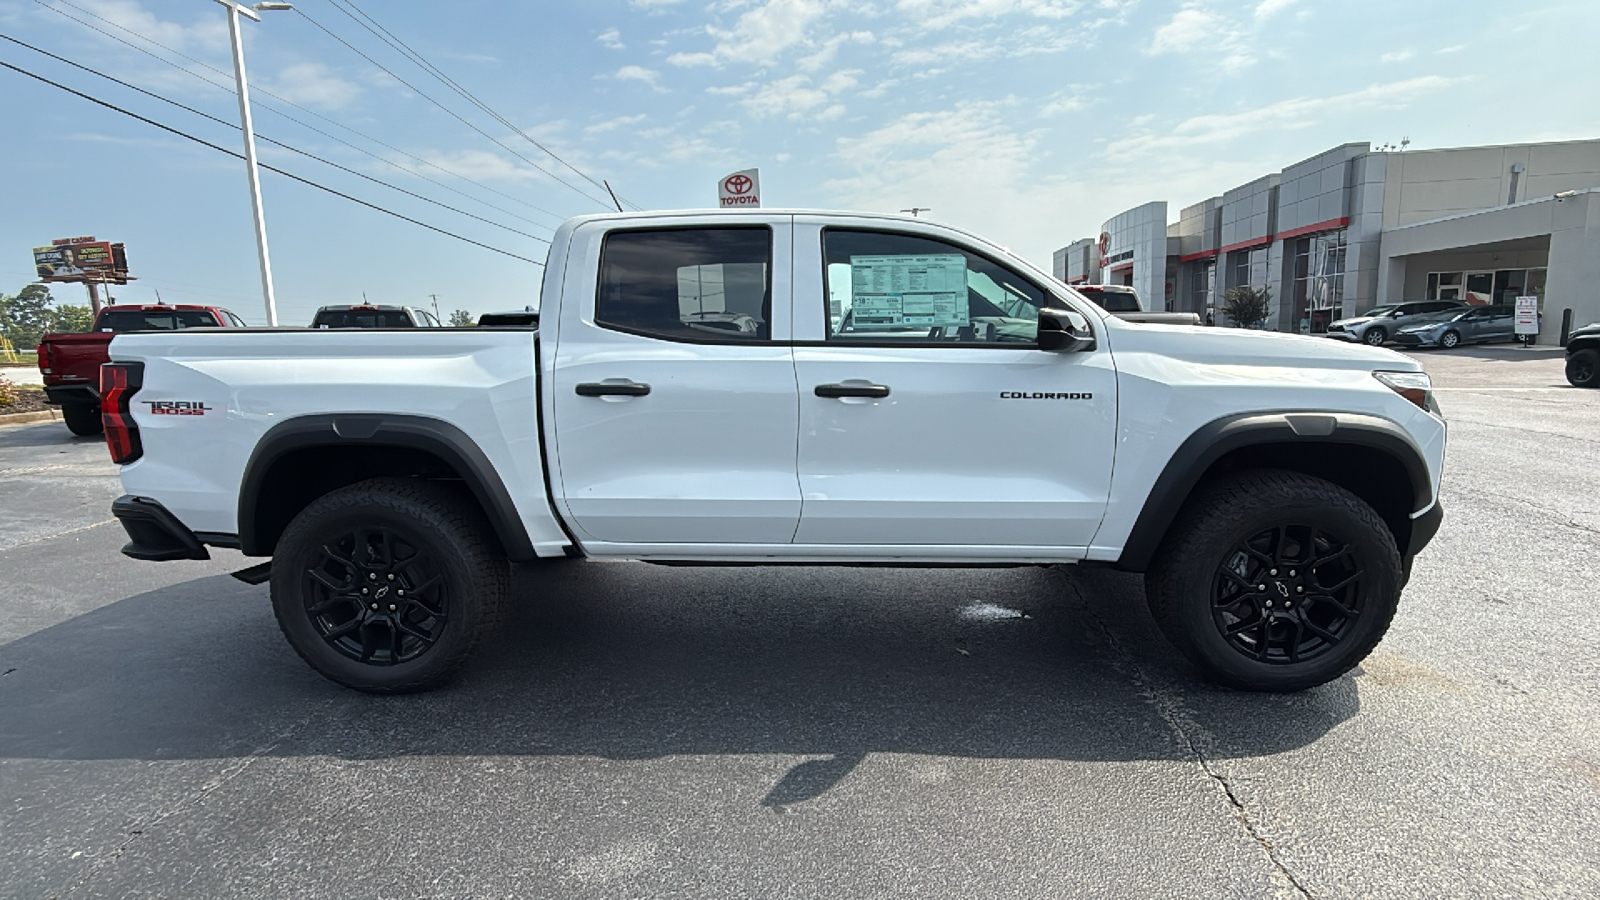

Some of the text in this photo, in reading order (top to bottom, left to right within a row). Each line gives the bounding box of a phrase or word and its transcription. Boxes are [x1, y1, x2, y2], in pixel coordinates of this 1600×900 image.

[721, 196, 759, 206] TOYOTA
[1000, 391, 1093, 400] COLORADO
[141, 401, 213, 410] TRAIL
[151, 408, 205, 416] BOSS
